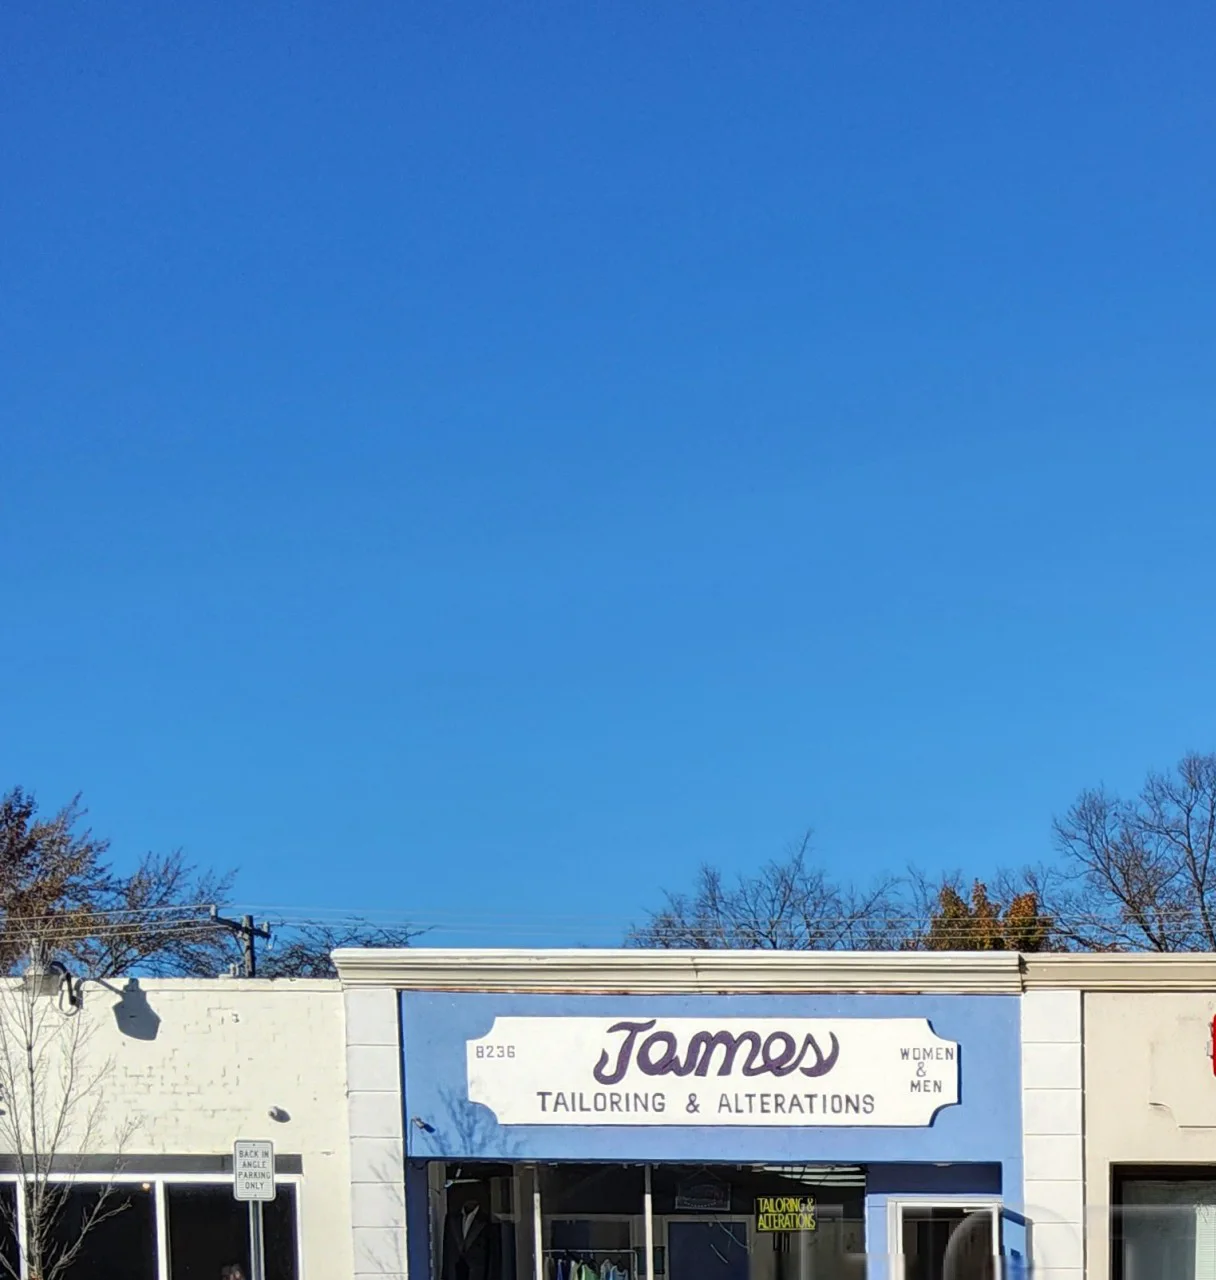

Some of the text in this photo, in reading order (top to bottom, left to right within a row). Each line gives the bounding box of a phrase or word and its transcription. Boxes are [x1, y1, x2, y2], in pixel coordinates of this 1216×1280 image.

[475, 1045, 516, 1059] 8236
[593, 1019, 840, 1085] James
[900, 1047, 954, 1060] WOMEN
[915, 1061, 927, 1077] &
[910, 1079, 942, 1092] MEN
[537, 1091, 875, 1114] TAILORING & ALTERATIONS
[239, 1150, 269, 1158] BACK IN
[242, 1160, 267, 1169] ANGLE
[238, 1171, 271, 1179] PARKING
[245, 1181, 264, 1190] ONLY
[757, 1197, 816, 1213] TAILORING &
[758, 1213, 816, 1229] ALTERATIONS
